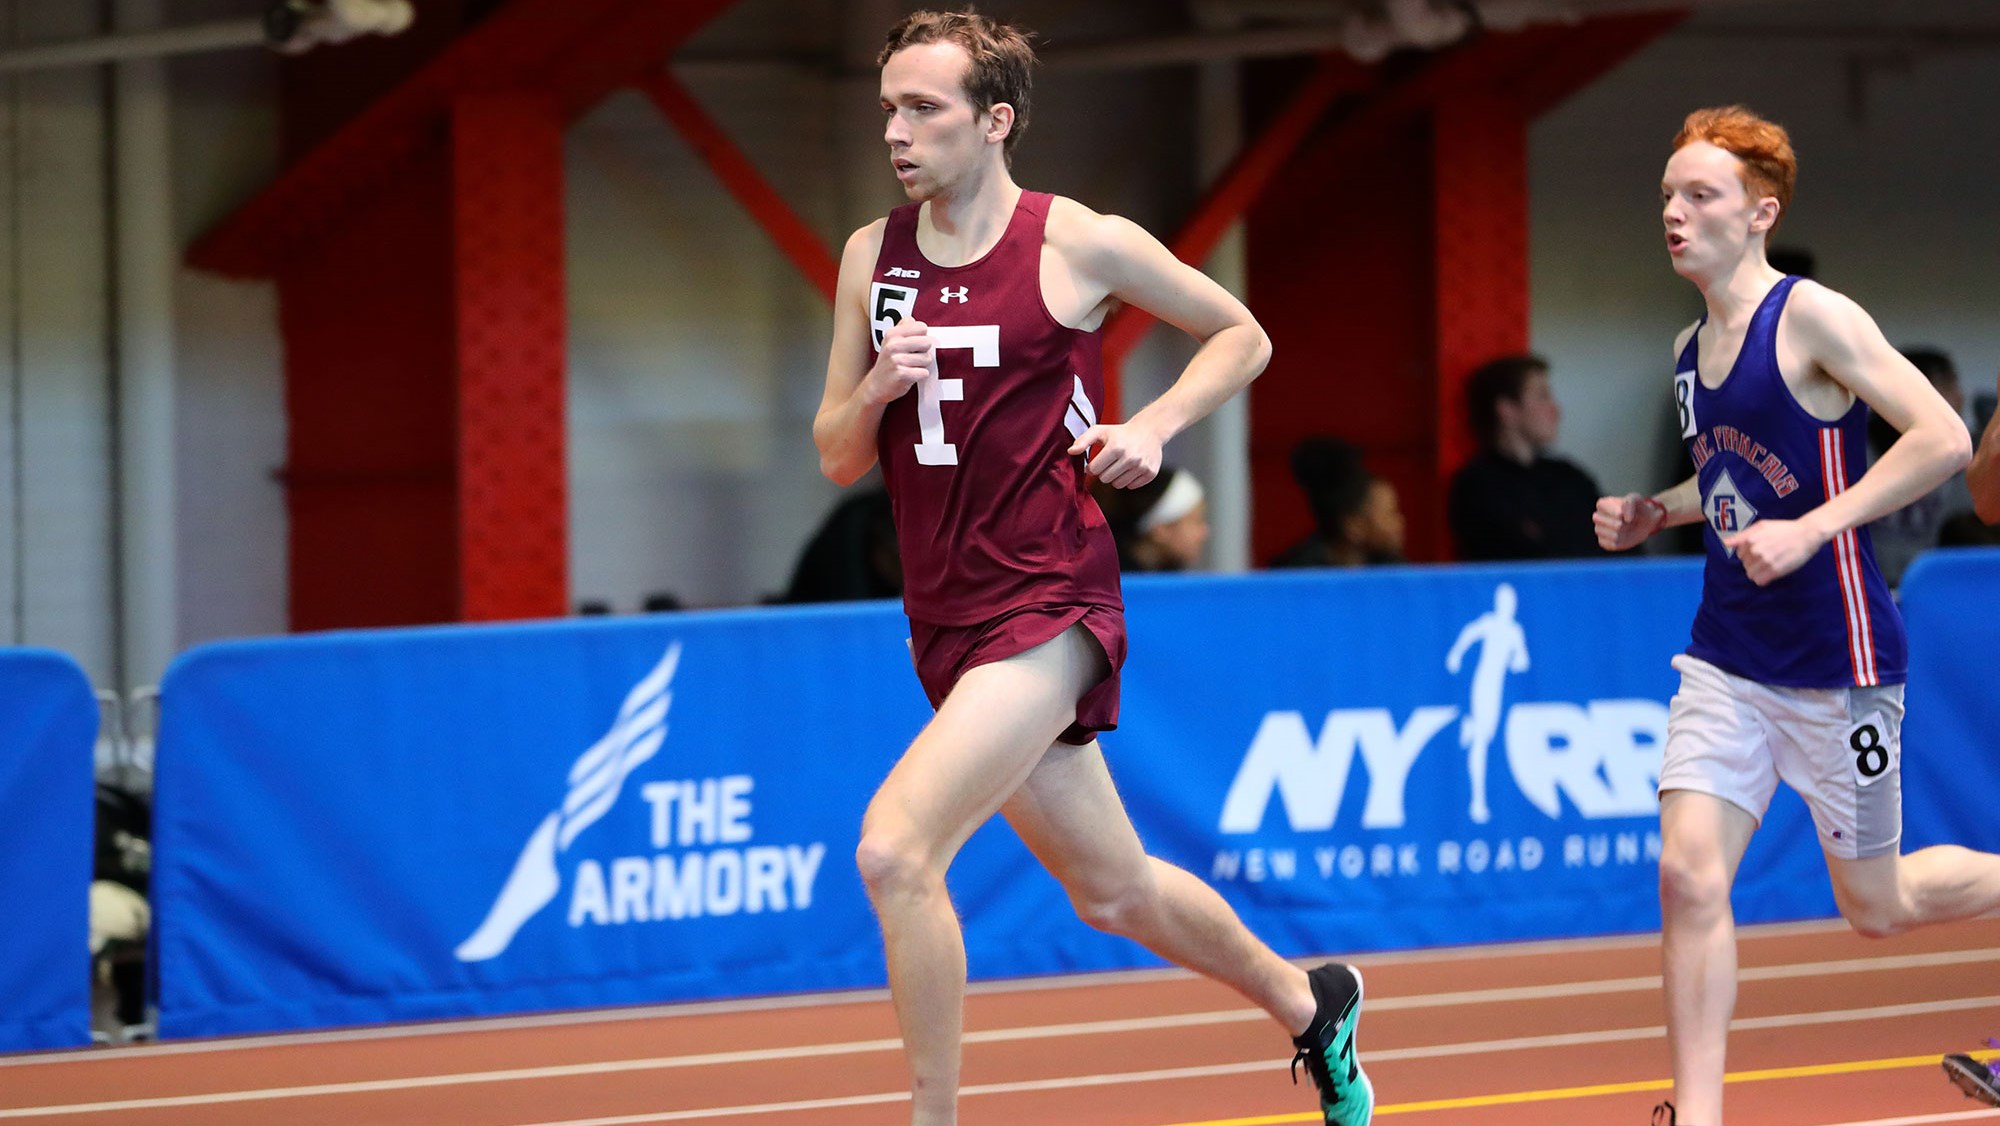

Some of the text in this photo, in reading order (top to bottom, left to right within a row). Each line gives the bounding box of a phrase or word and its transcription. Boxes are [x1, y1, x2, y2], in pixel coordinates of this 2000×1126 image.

[874, 287, 907, 348] 5
[913, 324, 1001, 466] F
[1676, 379, 1690, 434] 8
[1850, 724, 1889, 777] 8
[641, 774, 755, 849] THE
[567, 841, 827, 928] ARMORY
[1212, 847, 1297, 883] NEW
[1314, 842, 1421, 880] YORK
[1438, 836, 1545, 875] ROAD
